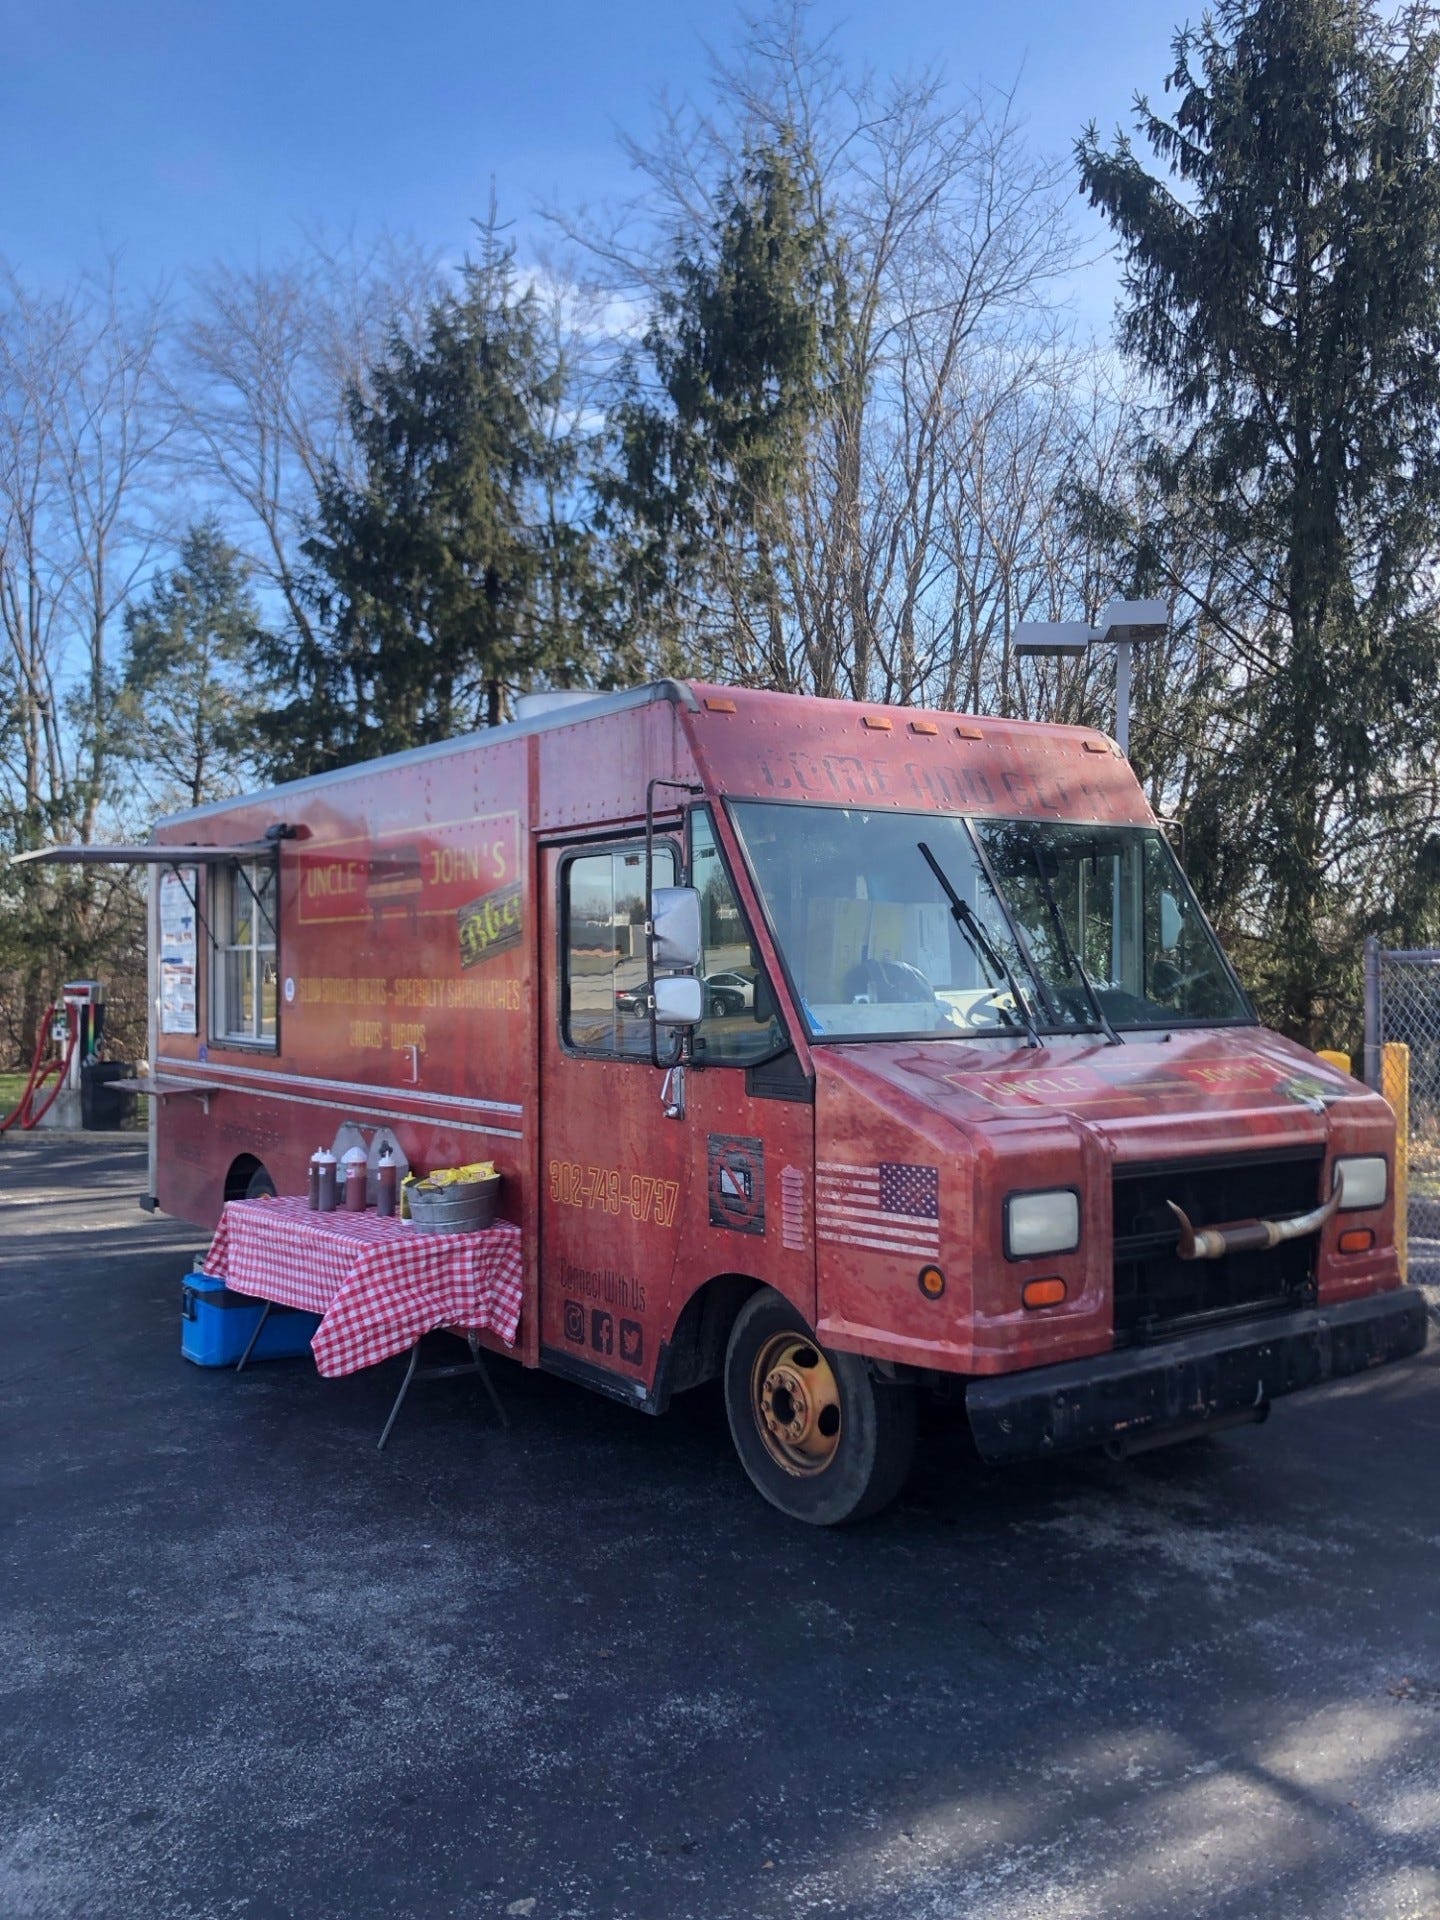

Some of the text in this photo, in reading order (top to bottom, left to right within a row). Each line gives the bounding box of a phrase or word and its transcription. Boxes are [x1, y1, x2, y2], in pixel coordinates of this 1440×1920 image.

[307, 841, 506, 898] UNCLE JOHN'S
[395, 979, 445, 1007] SPECIALTY
[447, 979, 520, 1010] SANDWICHES
[981, 1077, 1097, 1096] UNCLE
[550, 1160, 679, 1227] 302-743-9737
[560, 1258, 646, 1312] Connect With Us
